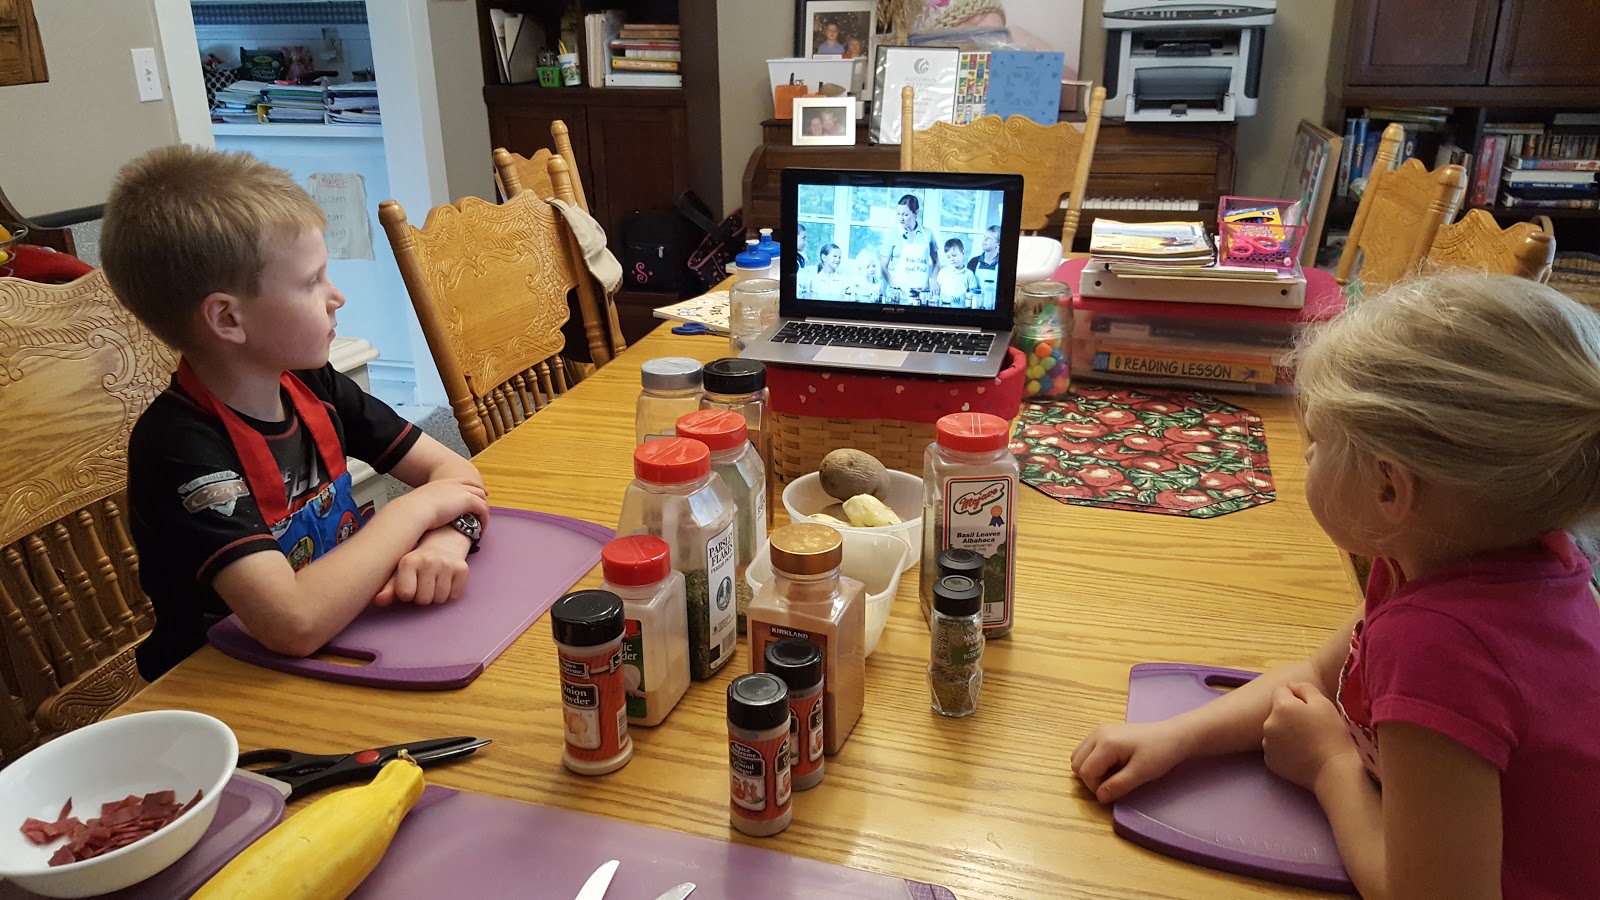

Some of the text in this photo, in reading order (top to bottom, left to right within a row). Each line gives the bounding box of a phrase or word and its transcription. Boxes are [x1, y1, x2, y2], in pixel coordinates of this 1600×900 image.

[1124, 357, 1179, 374] READING
[1182, 363, 1232, 379] LESSON
[959, 488, 998, 511] Mojave
[771, 626, 809, 639] KIRKLAND
[622, 642, 632, 651] lic
[621, 652, 637, 660] der
